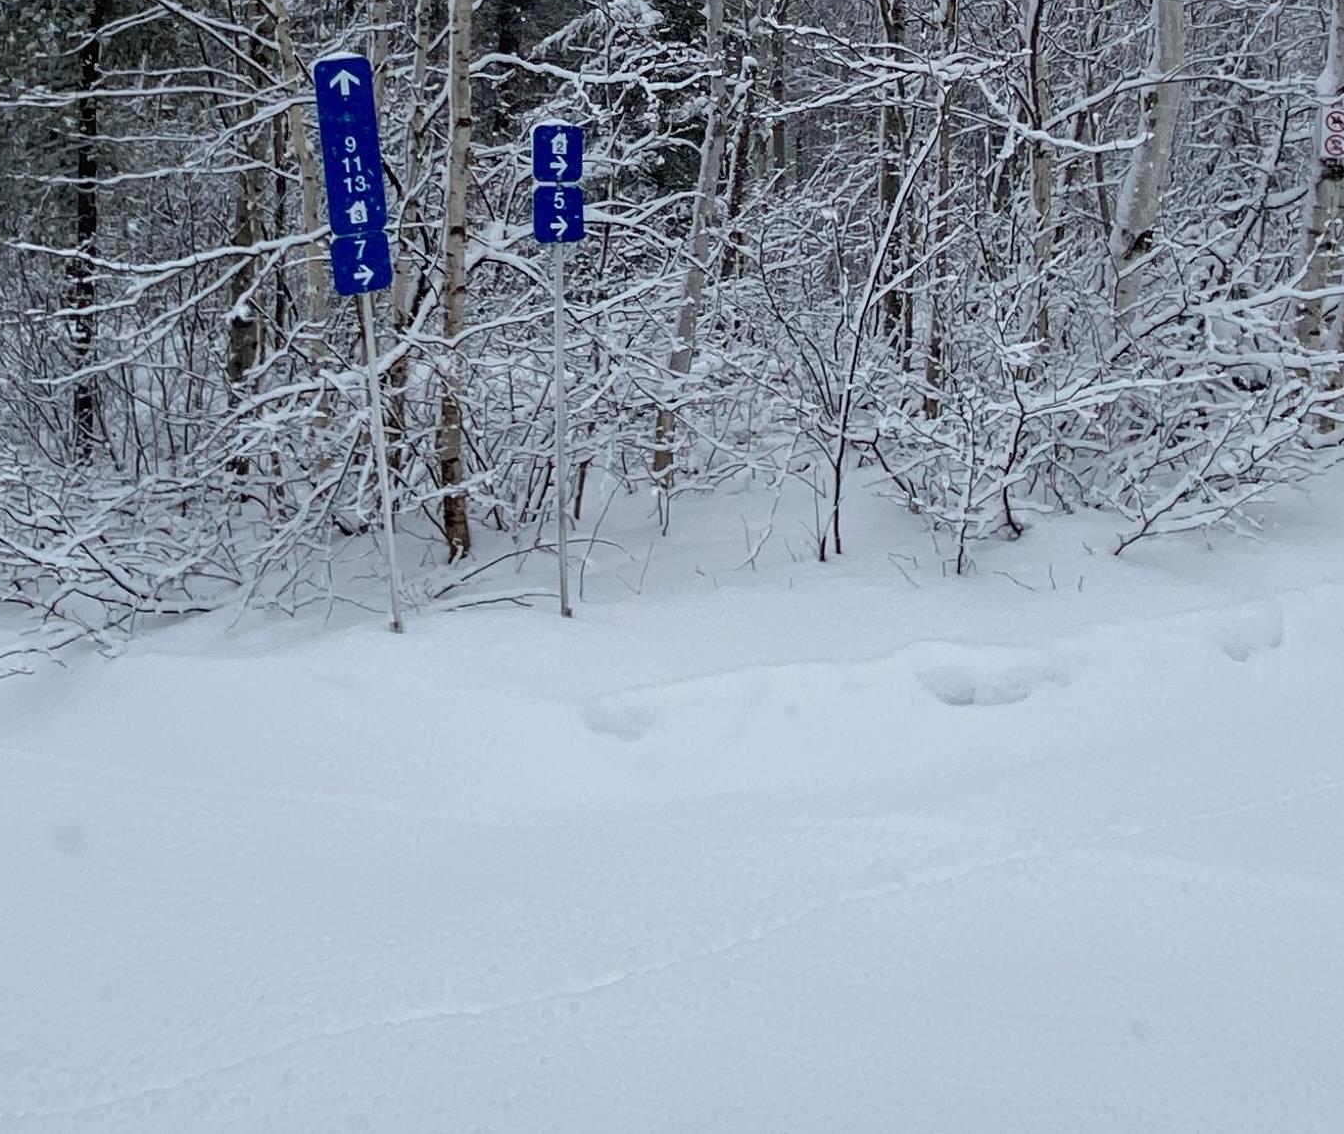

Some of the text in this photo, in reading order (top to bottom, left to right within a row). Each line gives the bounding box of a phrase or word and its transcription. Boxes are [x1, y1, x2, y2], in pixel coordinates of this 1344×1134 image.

[345, 136, 356, 153] 9
[556, 141, 564, 153] 2
[342, 156, 362, 173] 11
[343, 175, 367, 193] 13
[554, 192, 565, 209] 5
[354, 240, 366, 259] 7
